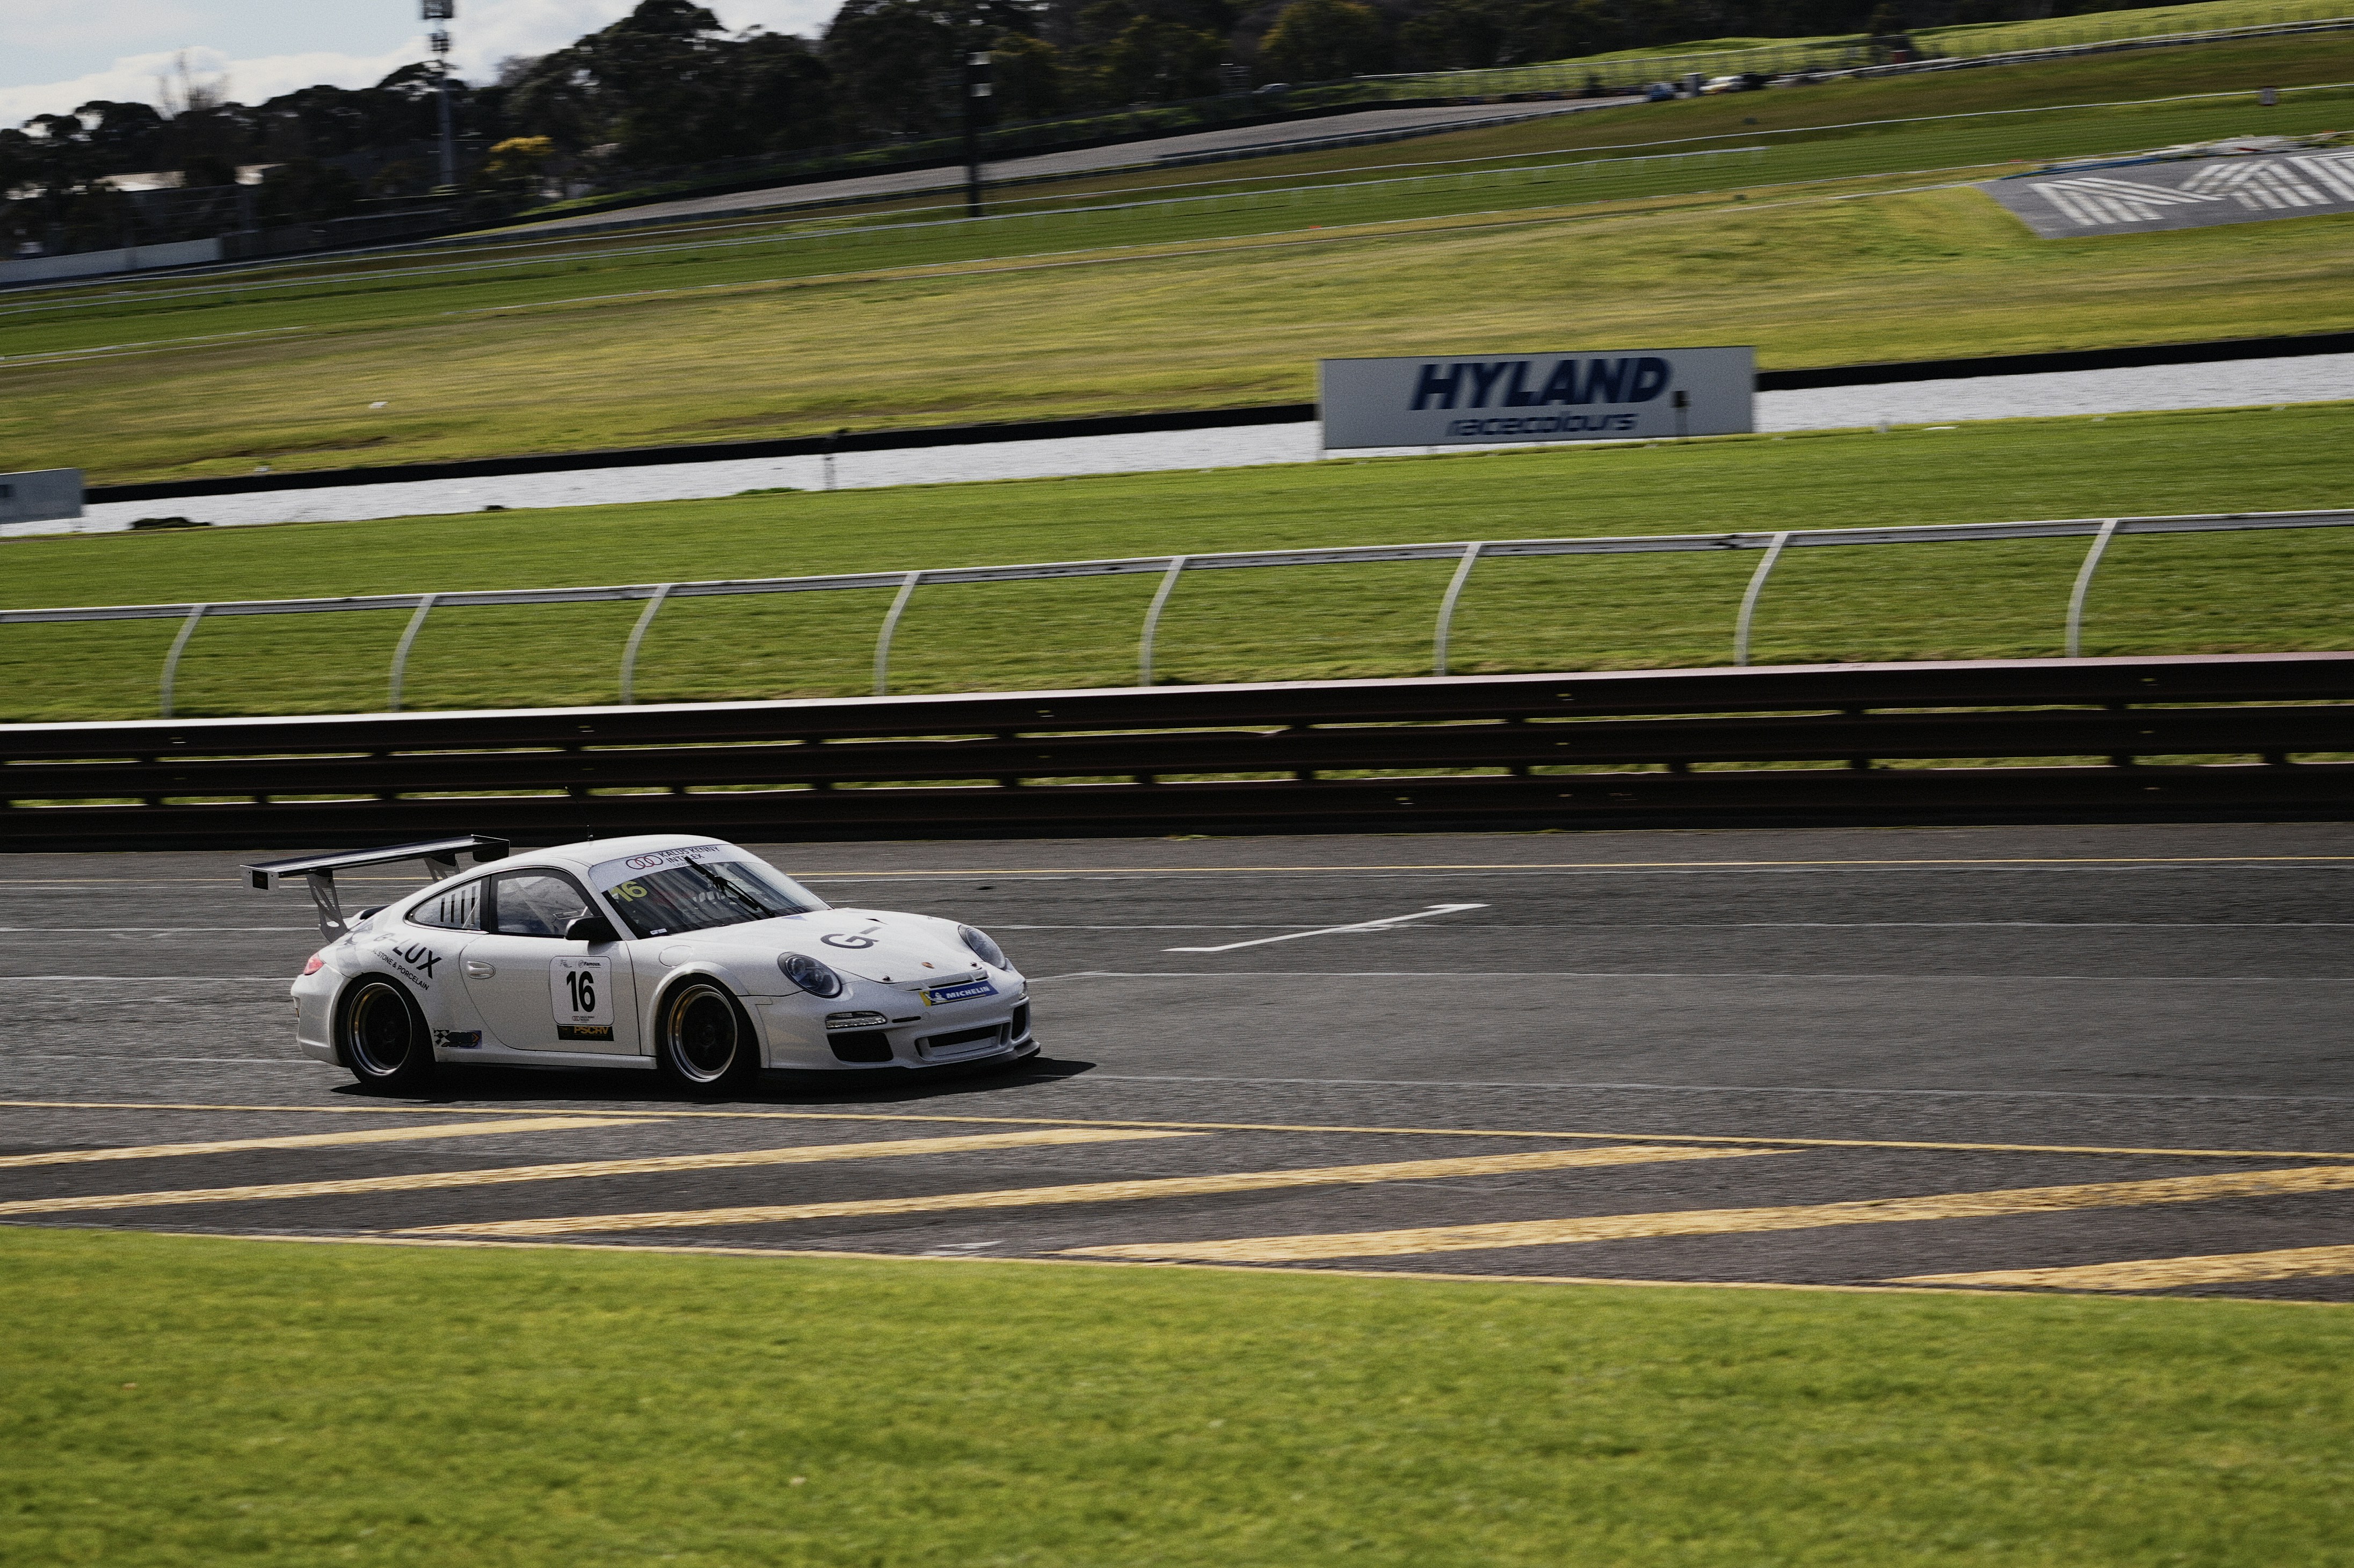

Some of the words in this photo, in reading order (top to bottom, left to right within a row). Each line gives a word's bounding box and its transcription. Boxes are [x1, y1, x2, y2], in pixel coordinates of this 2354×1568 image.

[1407, 357, 1672, 410] HYLAND
[1446, 412, 1638, 437] racecolours
[658, 848, 689, 858] KALUS
[610, 881, 648, 902] 16
[377, 951, 394, 965] STONE
[397, 965, 430, 991] PORCELAIN
[566, 971, 595, 1012] 16
[946, 986, 991, 999] MICHELIN
